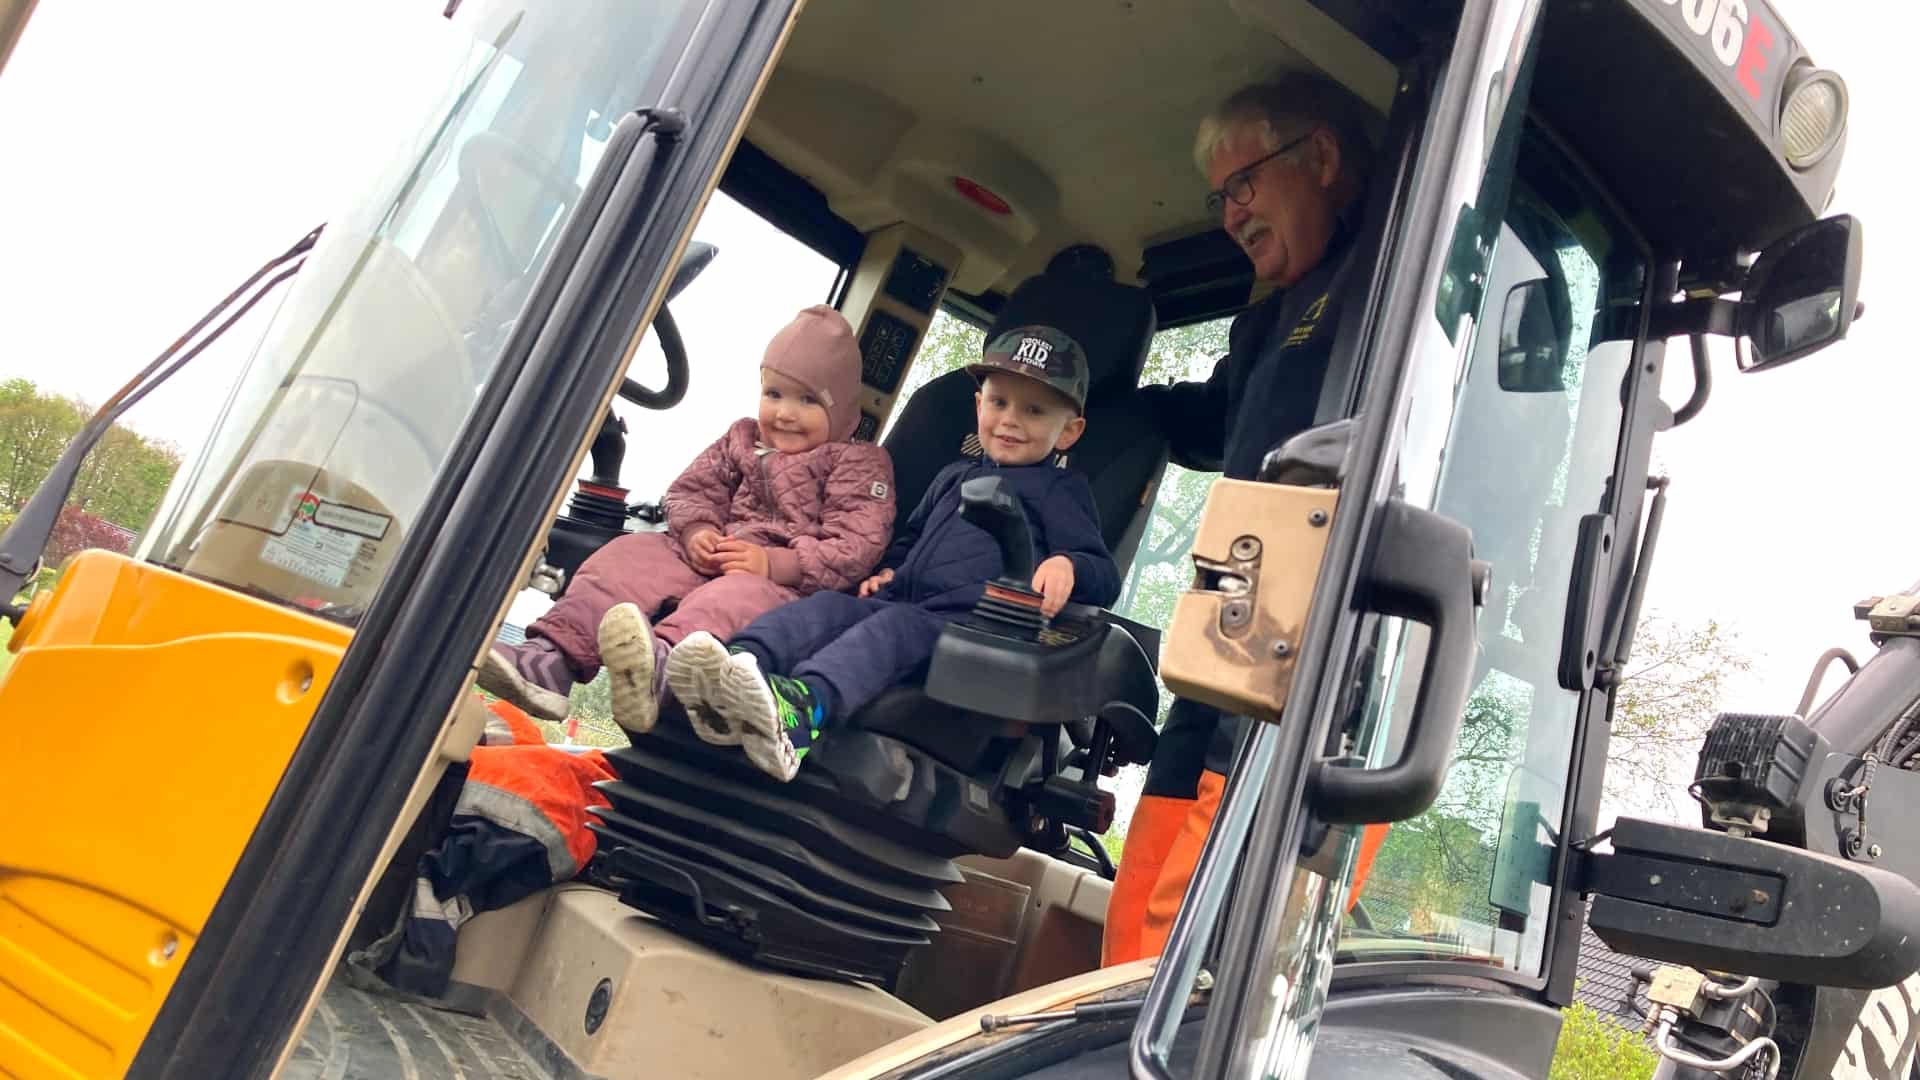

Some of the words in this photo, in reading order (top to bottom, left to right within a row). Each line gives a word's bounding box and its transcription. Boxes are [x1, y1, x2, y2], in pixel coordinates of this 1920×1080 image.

[1663, 0, 1774, 101] 06E
[1017, 342, 1048, 362] KID
[1022, 356, 1047, 369] TOWN
